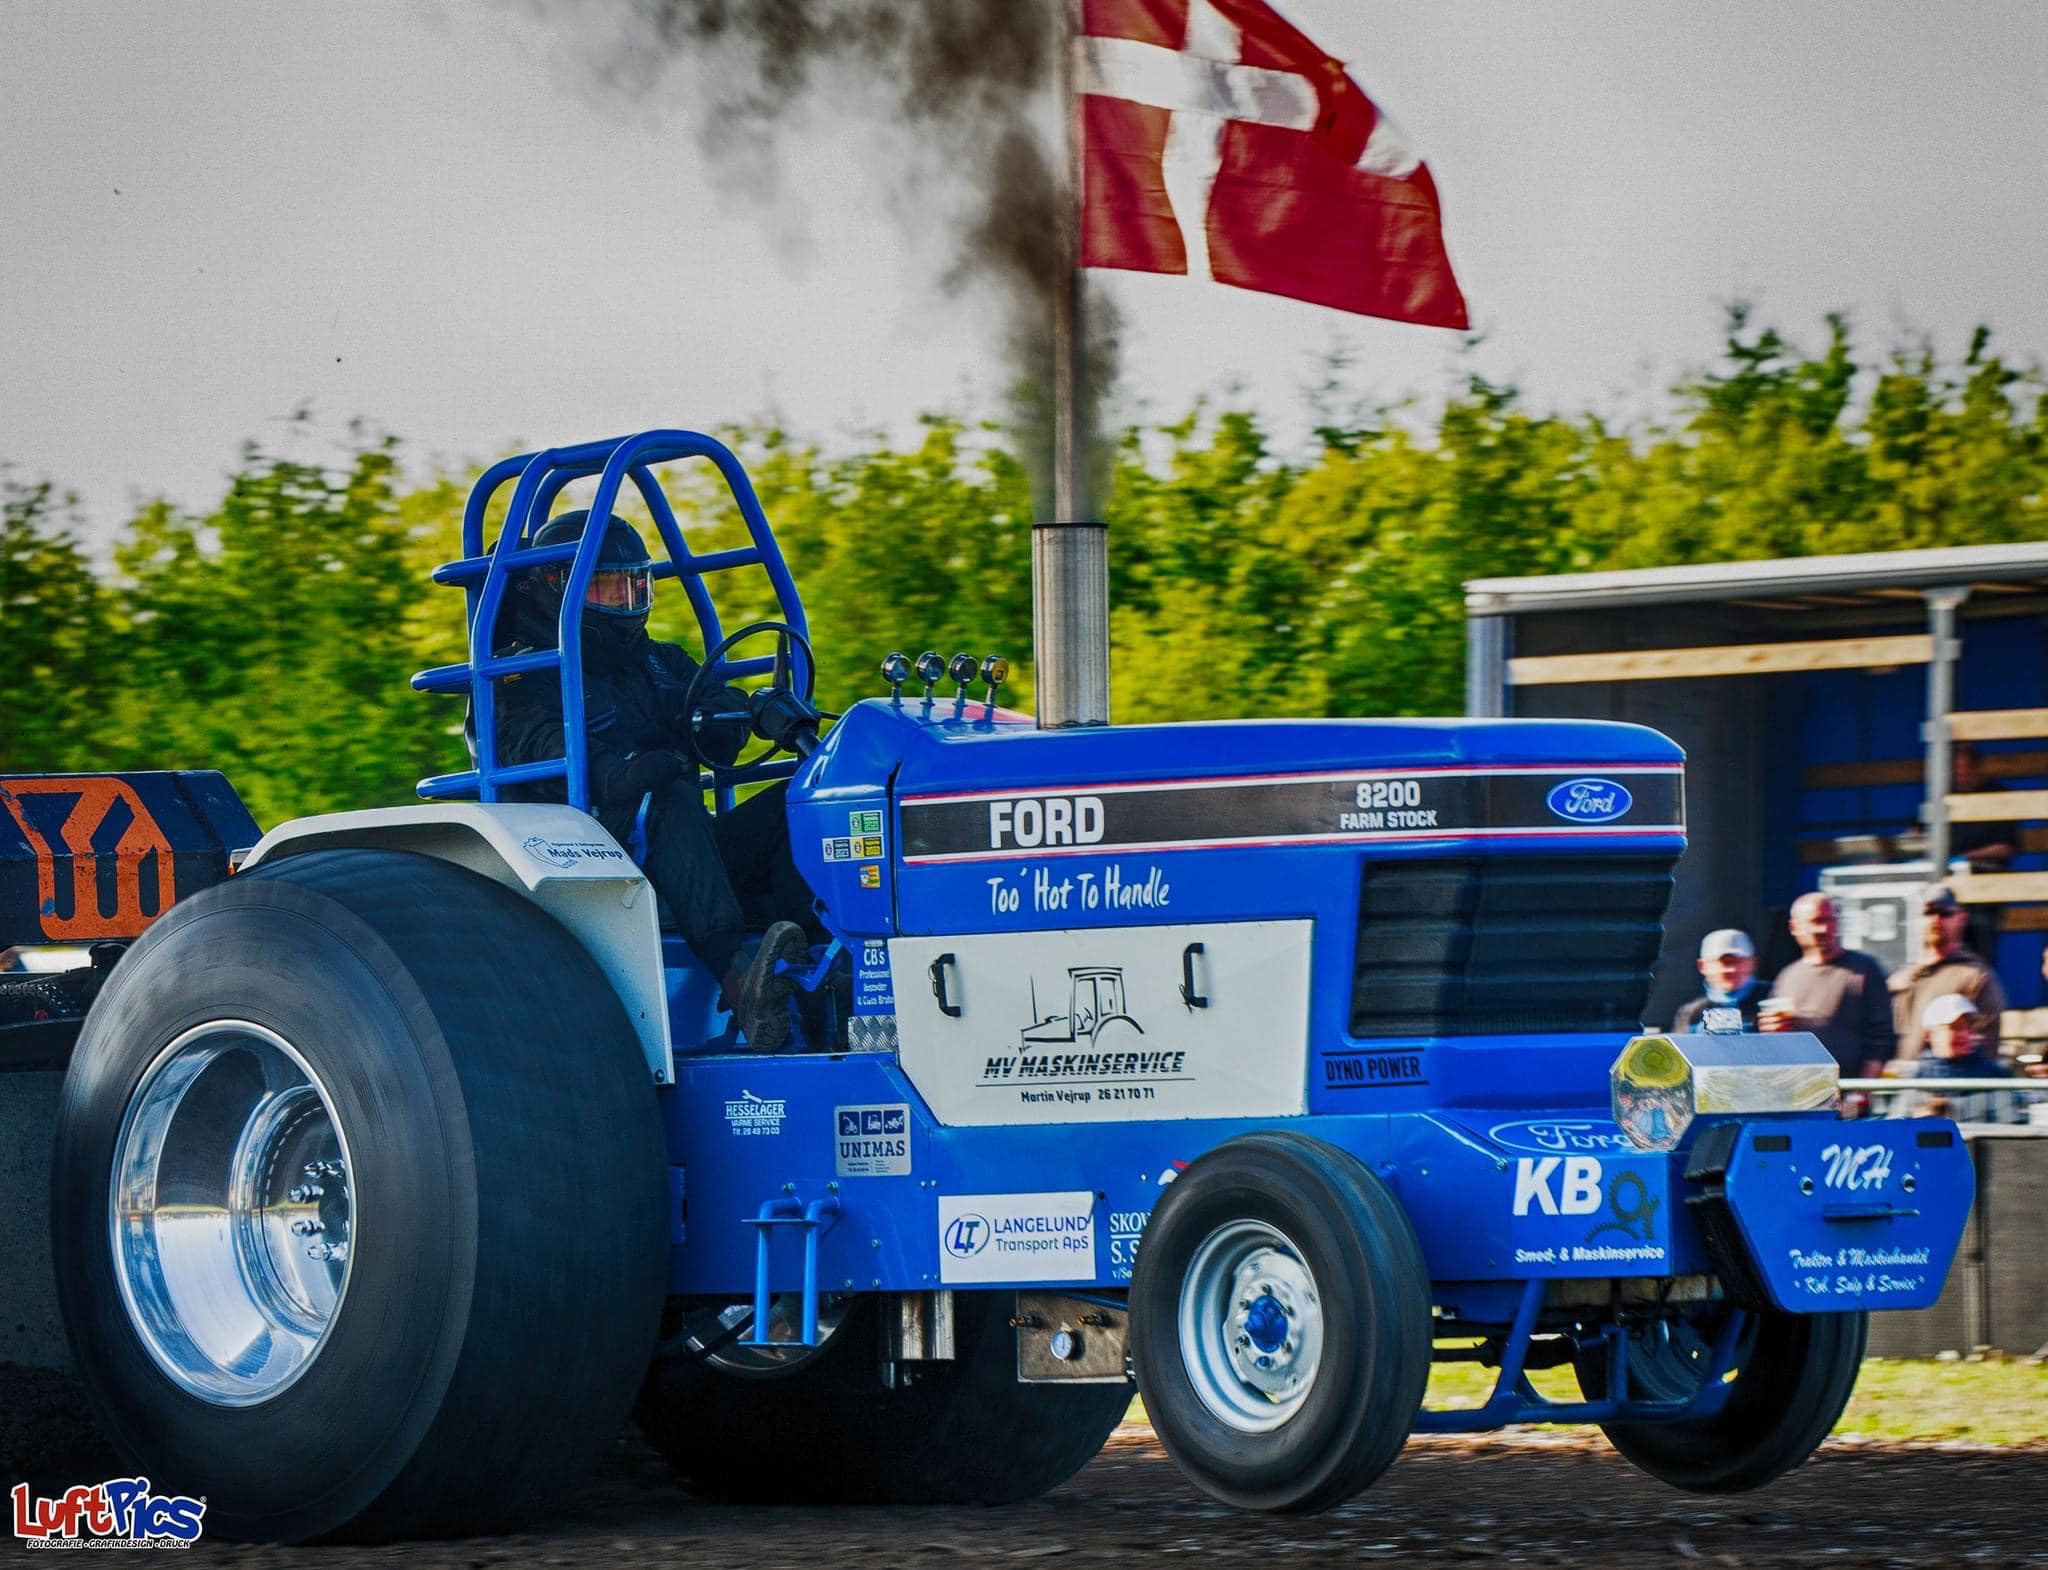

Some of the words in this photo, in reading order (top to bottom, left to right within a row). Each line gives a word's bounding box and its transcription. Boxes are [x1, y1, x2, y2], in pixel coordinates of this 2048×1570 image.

[1356, 781, 1421, 809] 8200
[1565, 784, 1617, 814] Ford
[989, 796, 1105, 849] FORD
[1340, 815, 1384, 830] FARM
[1387, 810, 1438, 828] STOCK
[547, 849, 580, 859] Mads
[582, 849, 624, 861] Vejrup
[1034, 866, 1074, 912] Hot
[1076, 872, 1099, 912] To
[1105, 863, 1170, 911] Handle
[984, 1056, 1016, 1079] MV
[1018, 1051, 1185, 1077] MASKINSERVICE
[1325, 1059, 1363, 1082] DYNO
[1367, 1055, 1421, 1080] POWER
[1021, 1090, 1054, 1103] Martin
[1057, 1089, 1091, 1104] Vejrup
[1098, 1088, 1111, 1100] 26
[1114, 1088, 1126, 1100] 21
[1128, 1087, 1141, 1099] 70
[1144, 1086, 1155, 1098] 71
[726, 1103, 785, 1117] HESSELAGER
[753, 1117, 780, 1127] SERVICE
[839, 1140, 905, 1158] UNIMAS
[1821, 1144, 1893, 1191] MH
[1512, 1156, 1602, 1216] KB
[994, 1216, 1088, 1234] LANGELUND
[996, 1240, 1059, 1254] Transport
[1062, 1236, 1089, 1253] ApS
[1559, 1246, 1569, 1261] &
